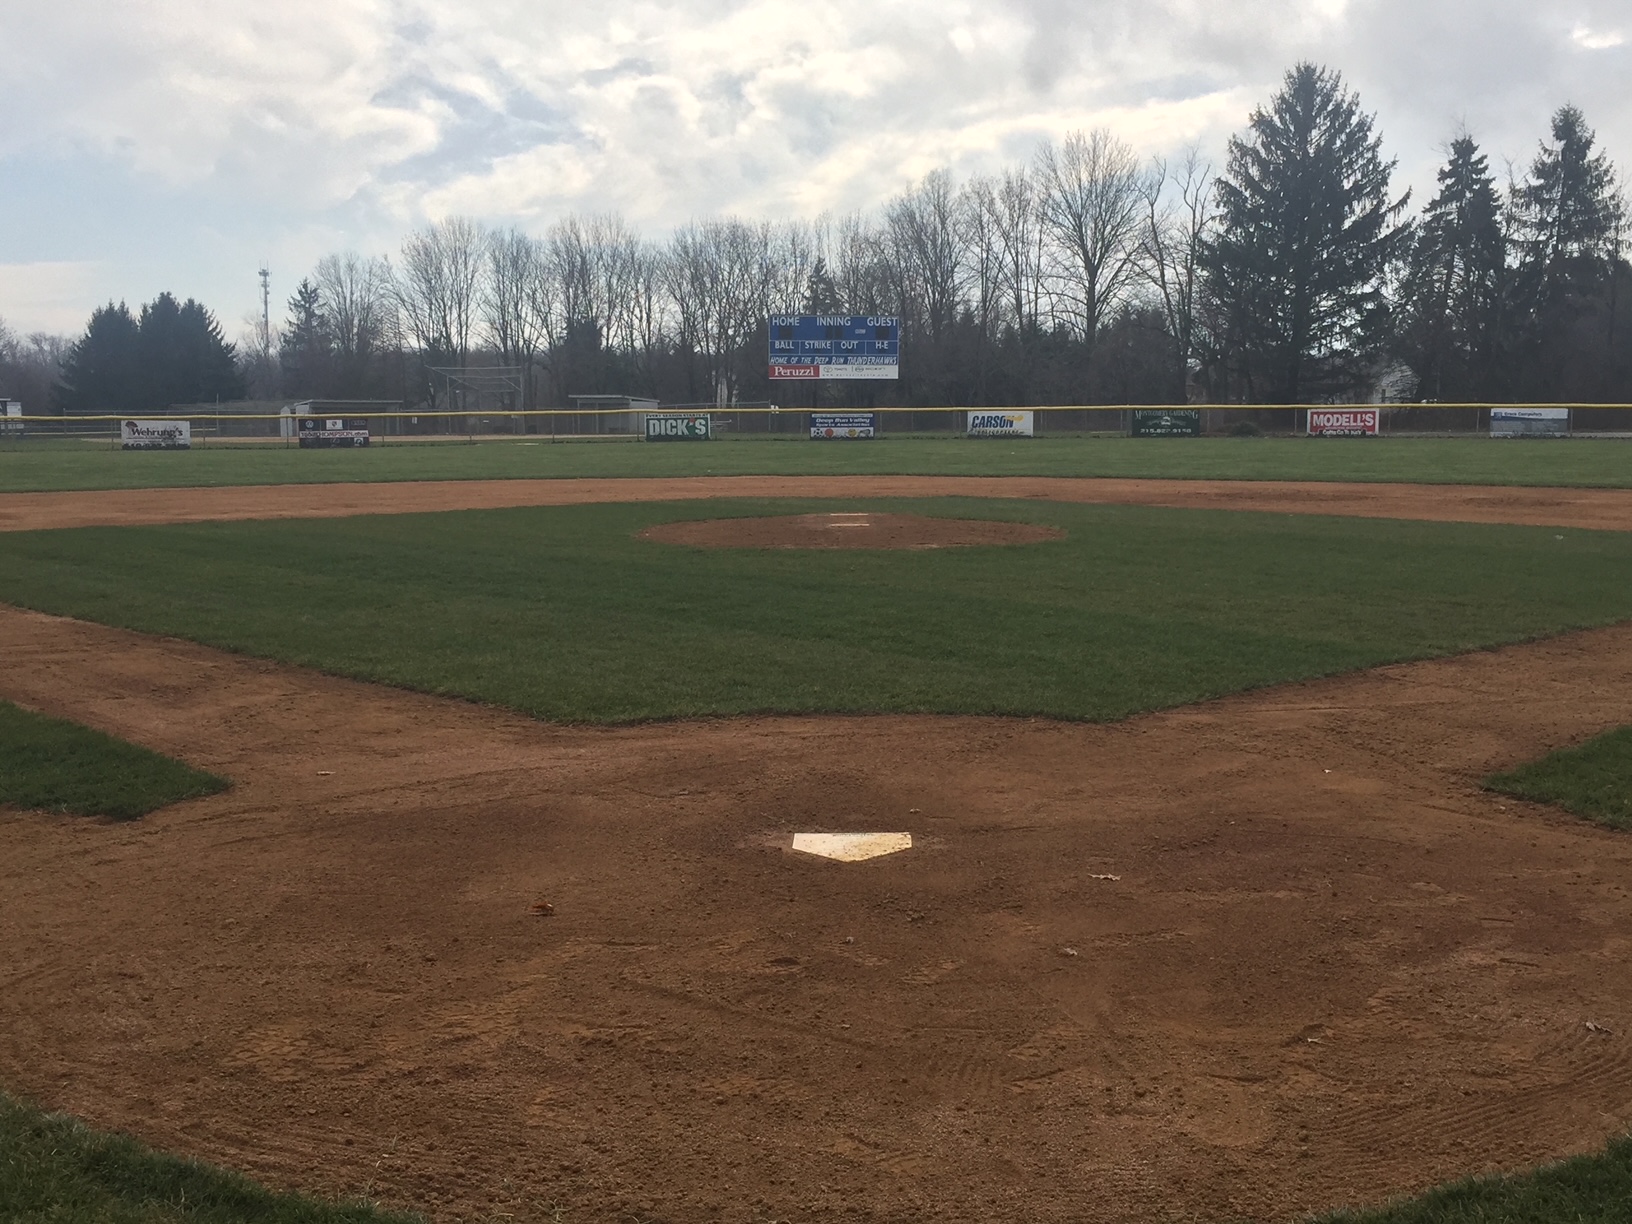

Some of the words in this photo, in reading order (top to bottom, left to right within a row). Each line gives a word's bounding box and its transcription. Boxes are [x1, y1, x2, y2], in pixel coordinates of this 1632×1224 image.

[772, 317, 800, 326] HOME
[816, 317, 851, 326] INNING
[866, 317, 898, 326] GUEST
[774, 341, 794, 349] BALL
[804, 341, 832, 349] STRIKE
[840, 341, 858, 349] OUT
[814, 356, 829, 364] DEEP
[831, 356, 845, 364] RUN
[847, 356, 897, 364] THUNDERHAWKS
[774, 366, 814, 376] Peruzzi
[972, 416, 1014, 428] CARSON
[1312, 414, 1374, 426] MODELL'S
[649, 419, 706, 436] DICK'S
